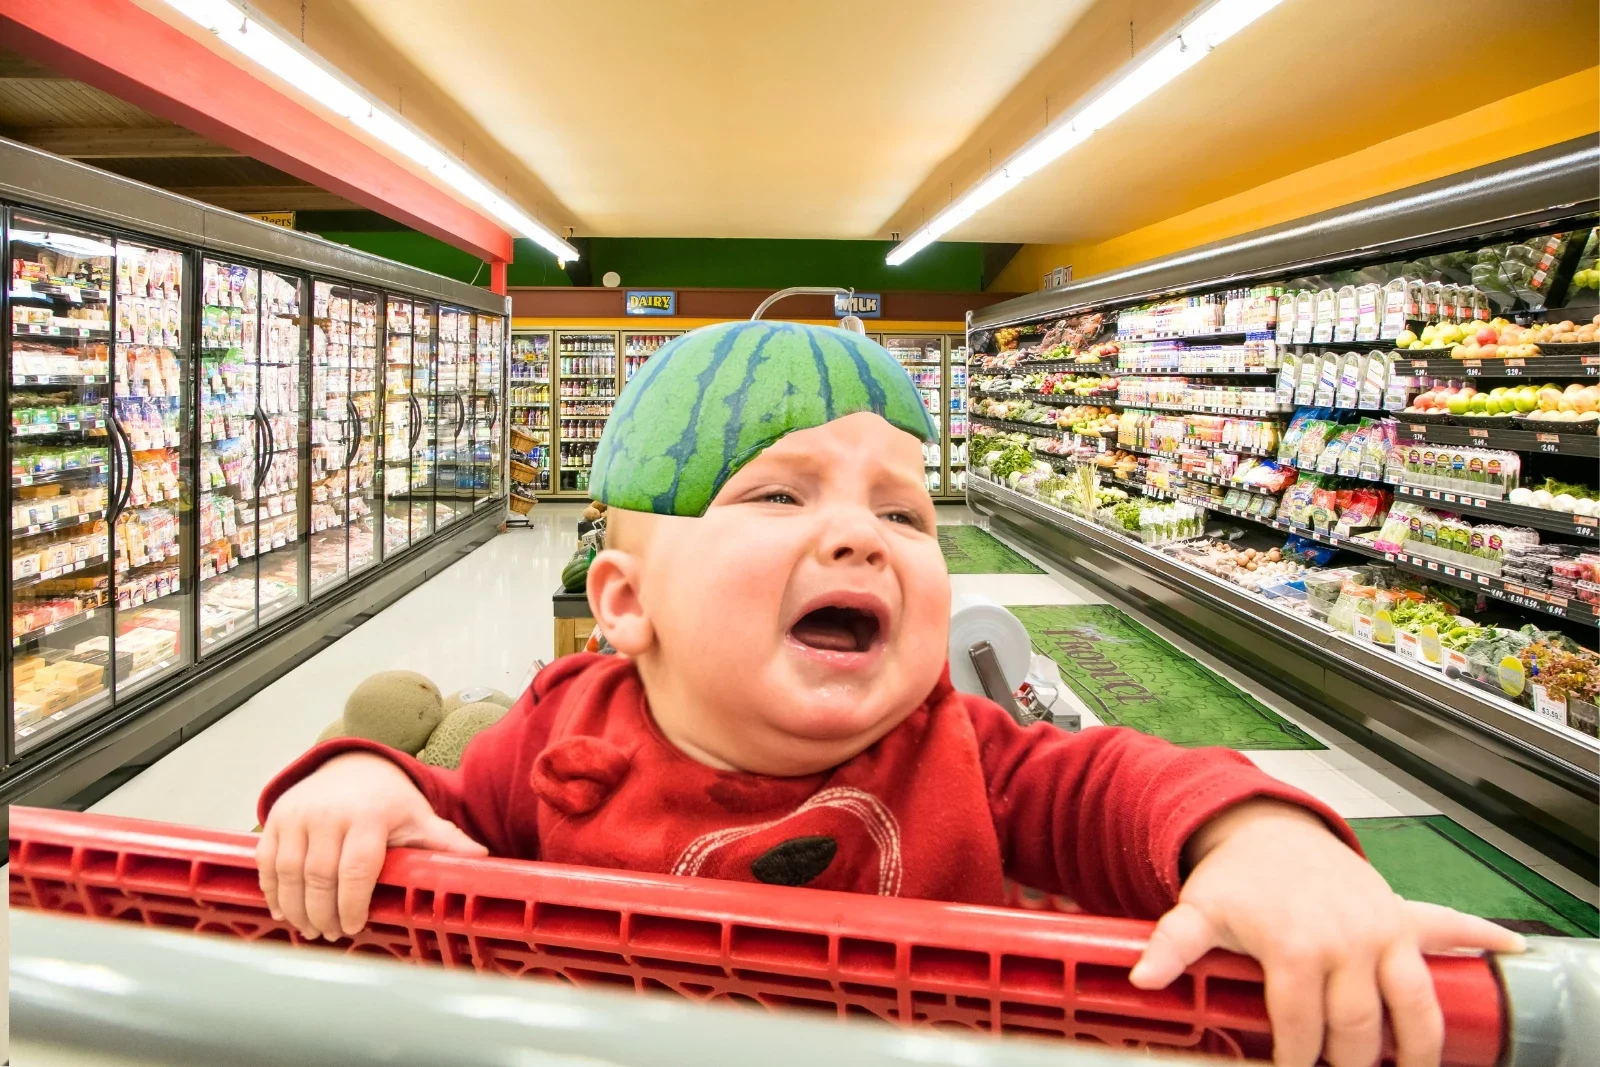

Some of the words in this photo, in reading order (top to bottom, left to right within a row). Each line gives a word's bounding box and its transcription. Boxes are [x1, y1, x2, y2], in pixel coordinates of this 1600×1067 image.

[629, 295, 672, 310] DAIRY
[837, 296, 878, 313] MILK
[1043, 630, 1159, 706] PRODUCE
